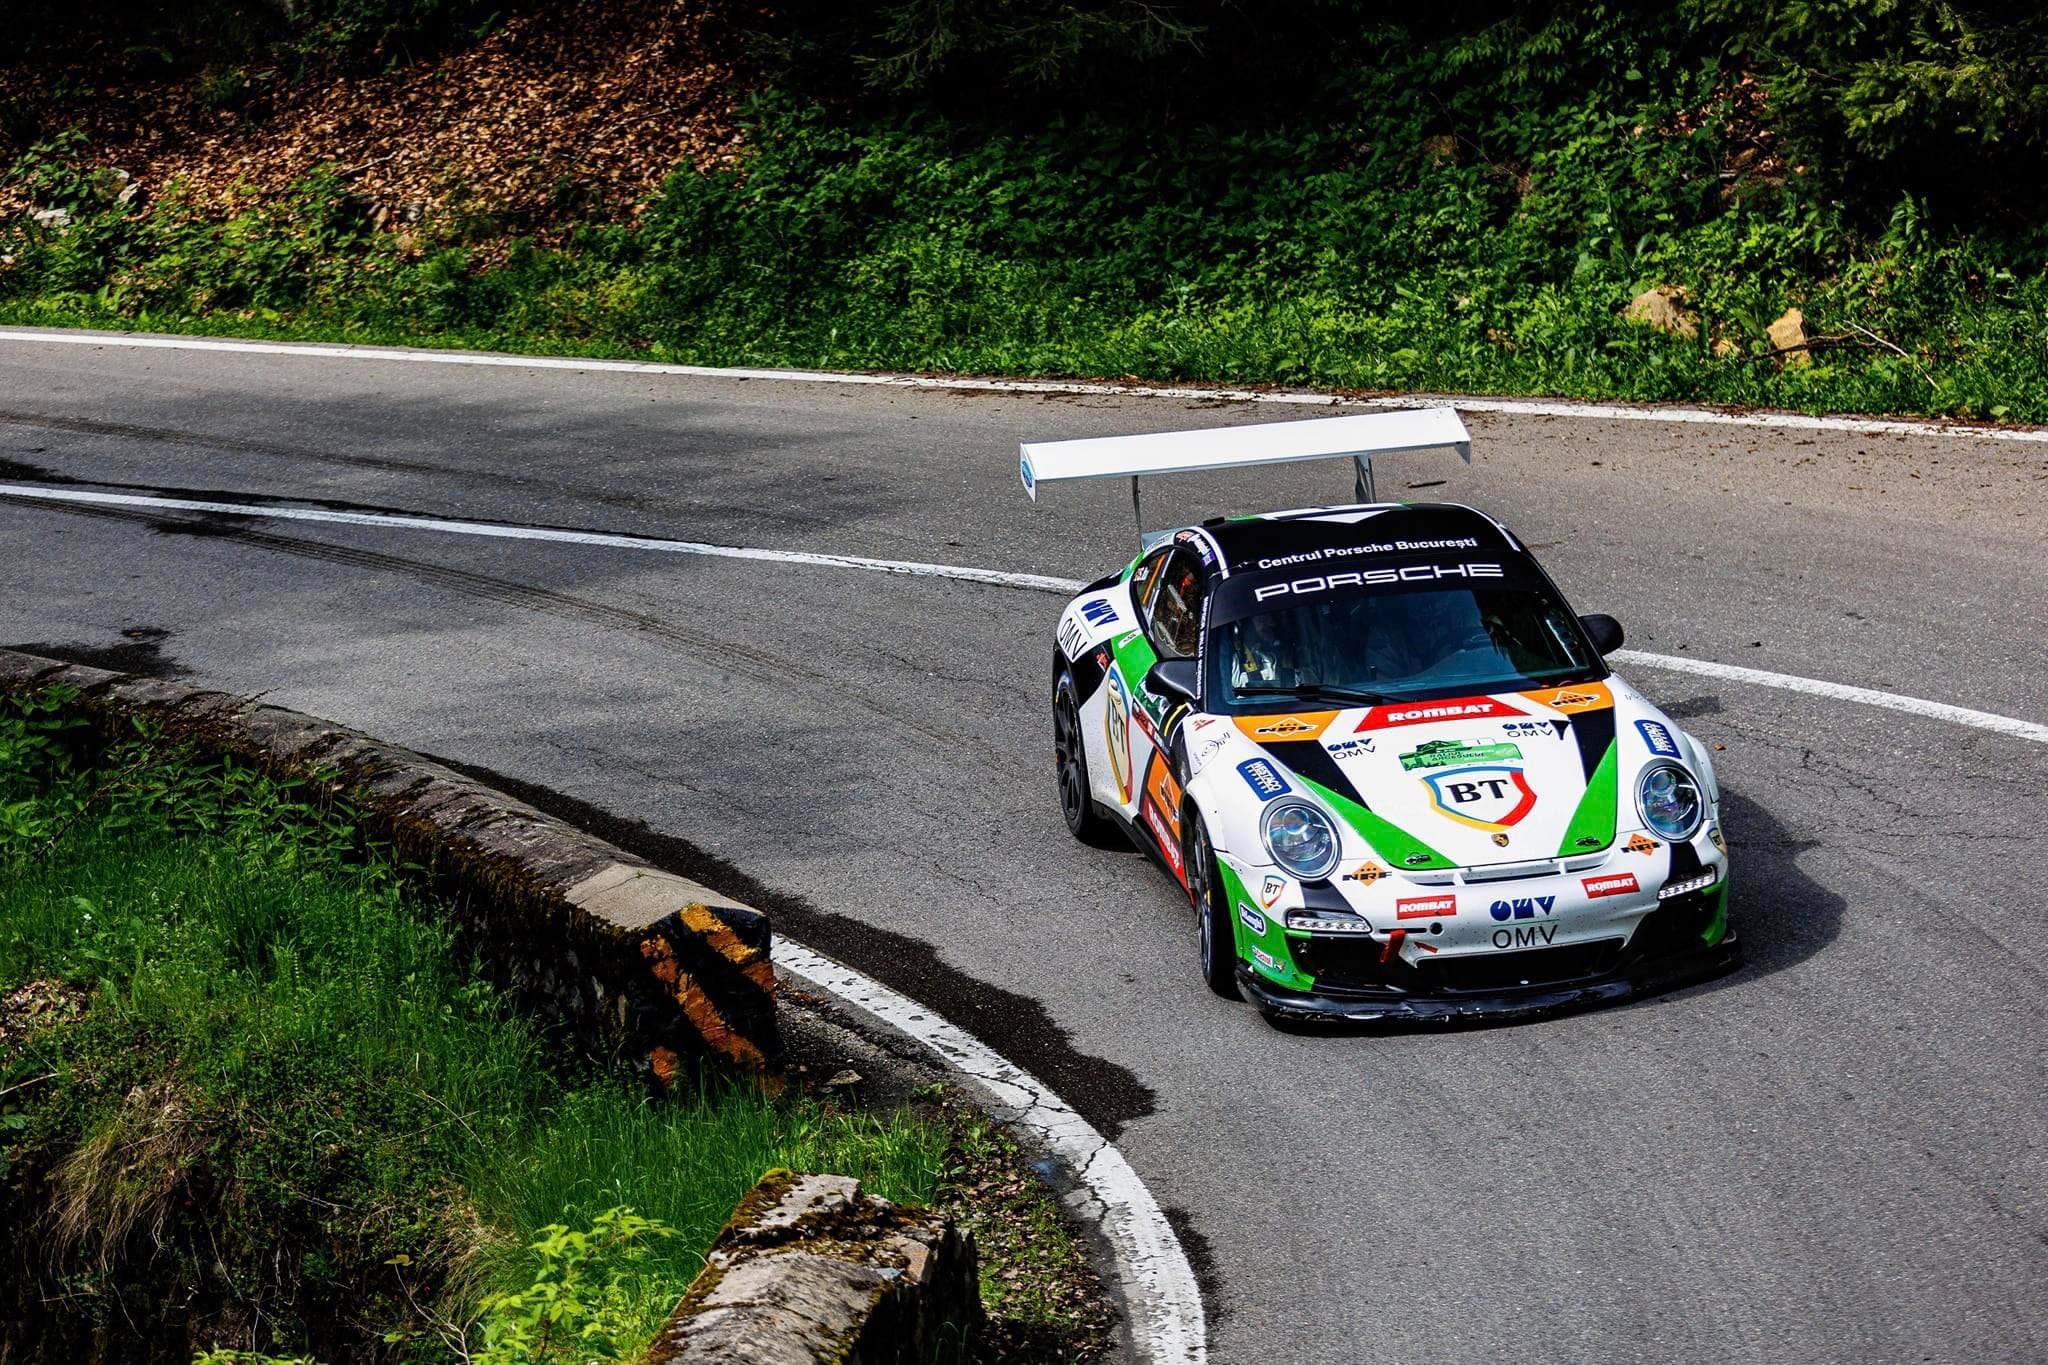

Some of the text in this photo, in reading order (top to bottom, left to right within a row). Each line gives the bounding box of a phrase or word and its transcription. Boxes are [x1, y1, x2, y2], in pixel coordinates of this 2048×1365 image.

[1258, 537, 1478, 569] Centrul Porsche București
[1254, 564, 1504, 602] PORSCHE
[1060, 617, 1088, 660] OMV
[1387, 703, 1494, 722] ROMBAT
[1257, 725, 1316, 734] NRF
[1507, 730, 1553, 738] OMV
[1333, 745, 1376, 760] OMV
[1445, 779, 1509, 803] BT
[1342, 870, 1392, 881] NRF
[1264, 883, 1280, 895] BT
[1586, 877, 1636, 893] ROMBAT
[1398, 900, 1453, 914] ROMBAT
[1492, 924, 1558, 949] OMV
